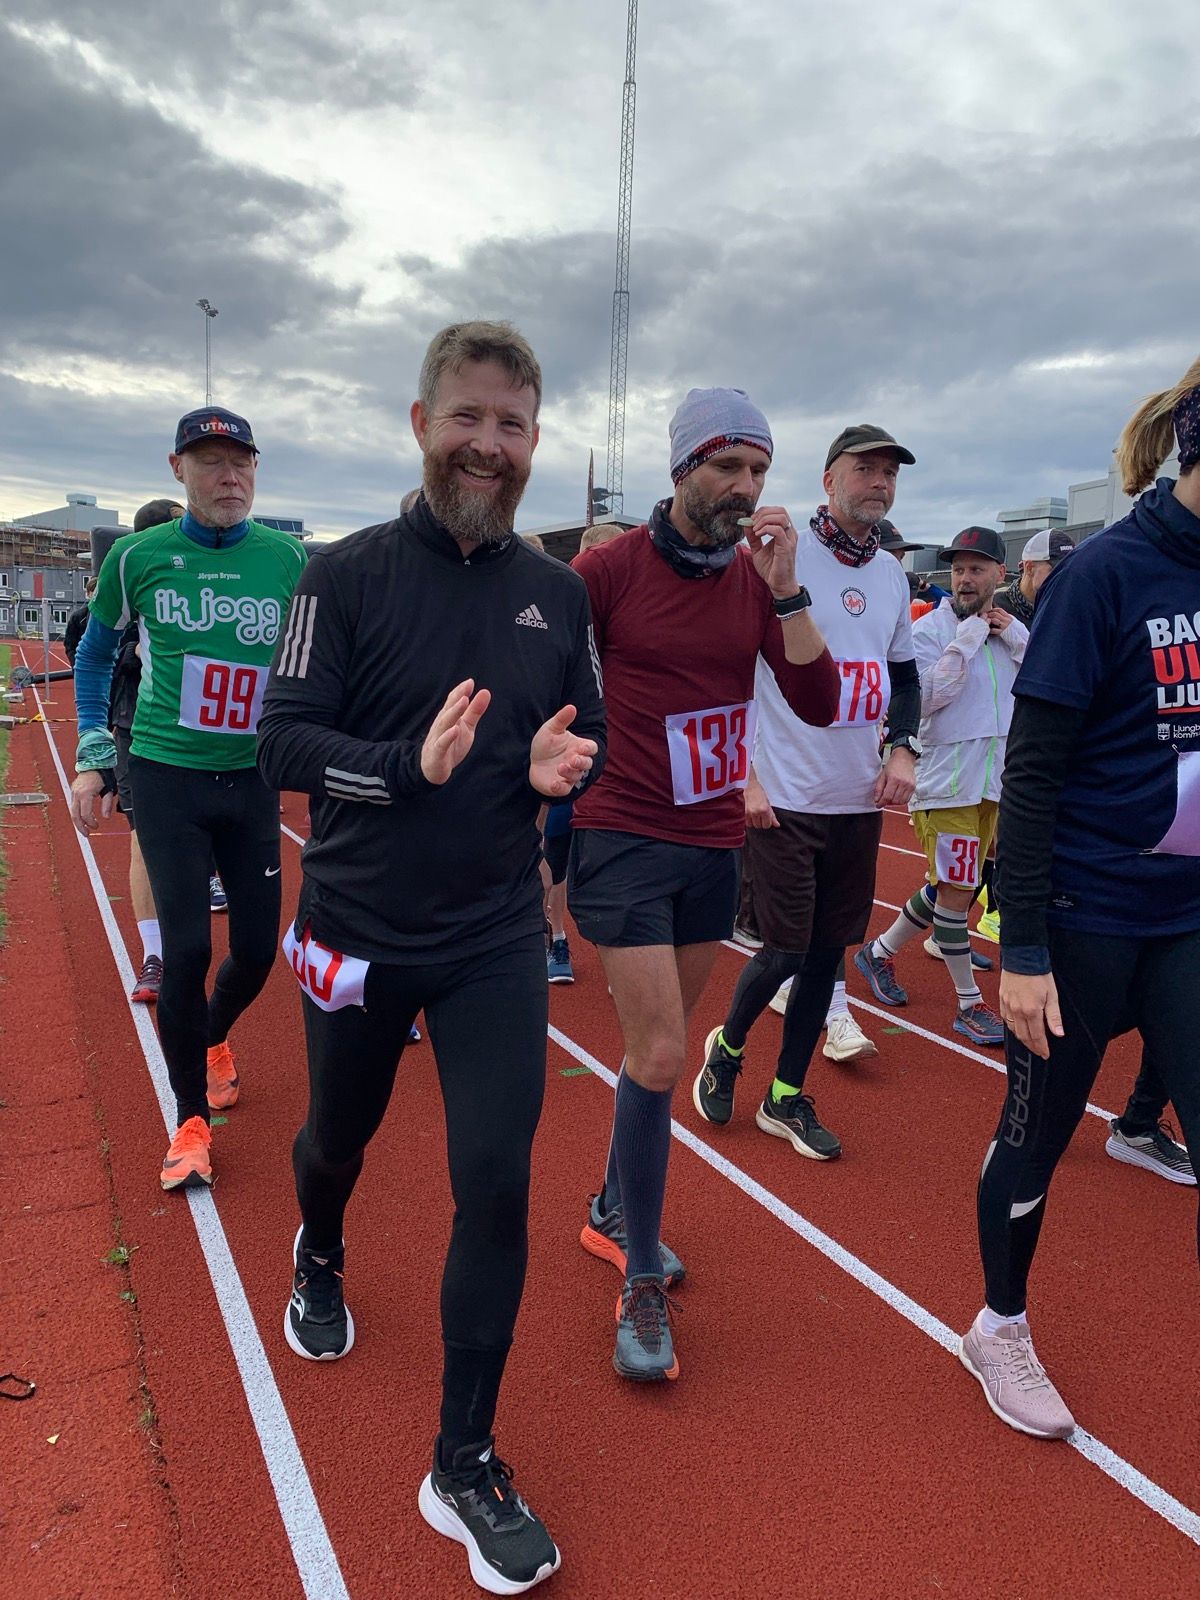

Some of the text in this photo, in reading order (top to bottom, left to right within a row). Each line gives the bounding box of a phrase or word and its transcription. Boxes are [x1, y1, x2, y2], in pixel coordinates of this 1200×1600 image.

[200, 422, 239, 433] UTMB
[515, 617, 548, 629] adidas
[199, 663, 258, 729] 99
[834, 661, 883, 721] 78
[683, 708, 746, 795] 133
